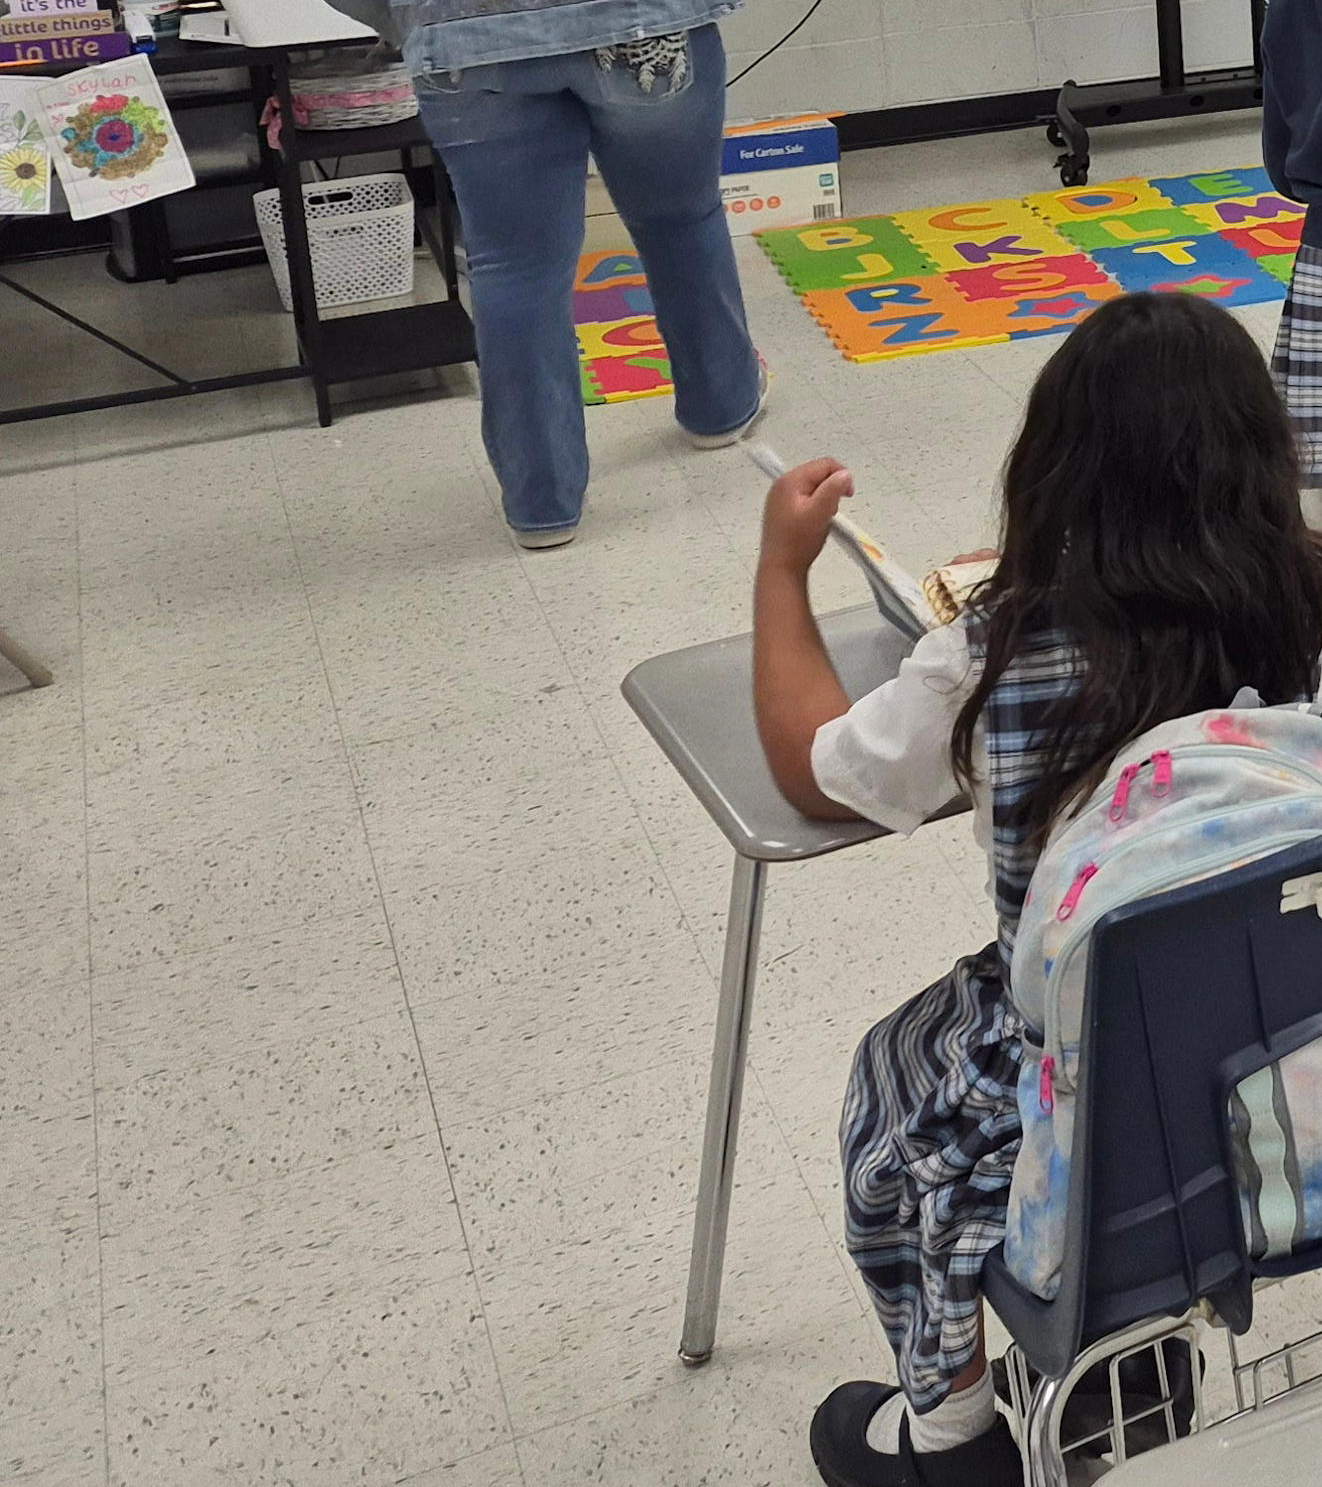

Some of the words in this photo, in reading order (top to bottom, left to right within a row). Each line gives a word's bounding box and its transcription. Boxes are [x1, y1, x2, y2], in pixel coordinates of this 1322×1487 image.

[1, 21, 48, 36] little
[52, 16, 112, 32] things
[14, 42, 45, 60] in
[51, 38, 100, 60] life
[1189, 173, 1254, 196] E
[1056, 190, 1137, 213] D
[928, 207, 1008, 231] C
[1100, 220, 1171, 239] L
[797, 226, 874, 251] B
[953, 235, 1043, 263] K
[1132, 240, 1196, 265] T
[841, 253, 894, 280] J
[992, 263, 1067, 291] S
[845, 283, 933, 312] R
[868, 312, 960, 344] Z
